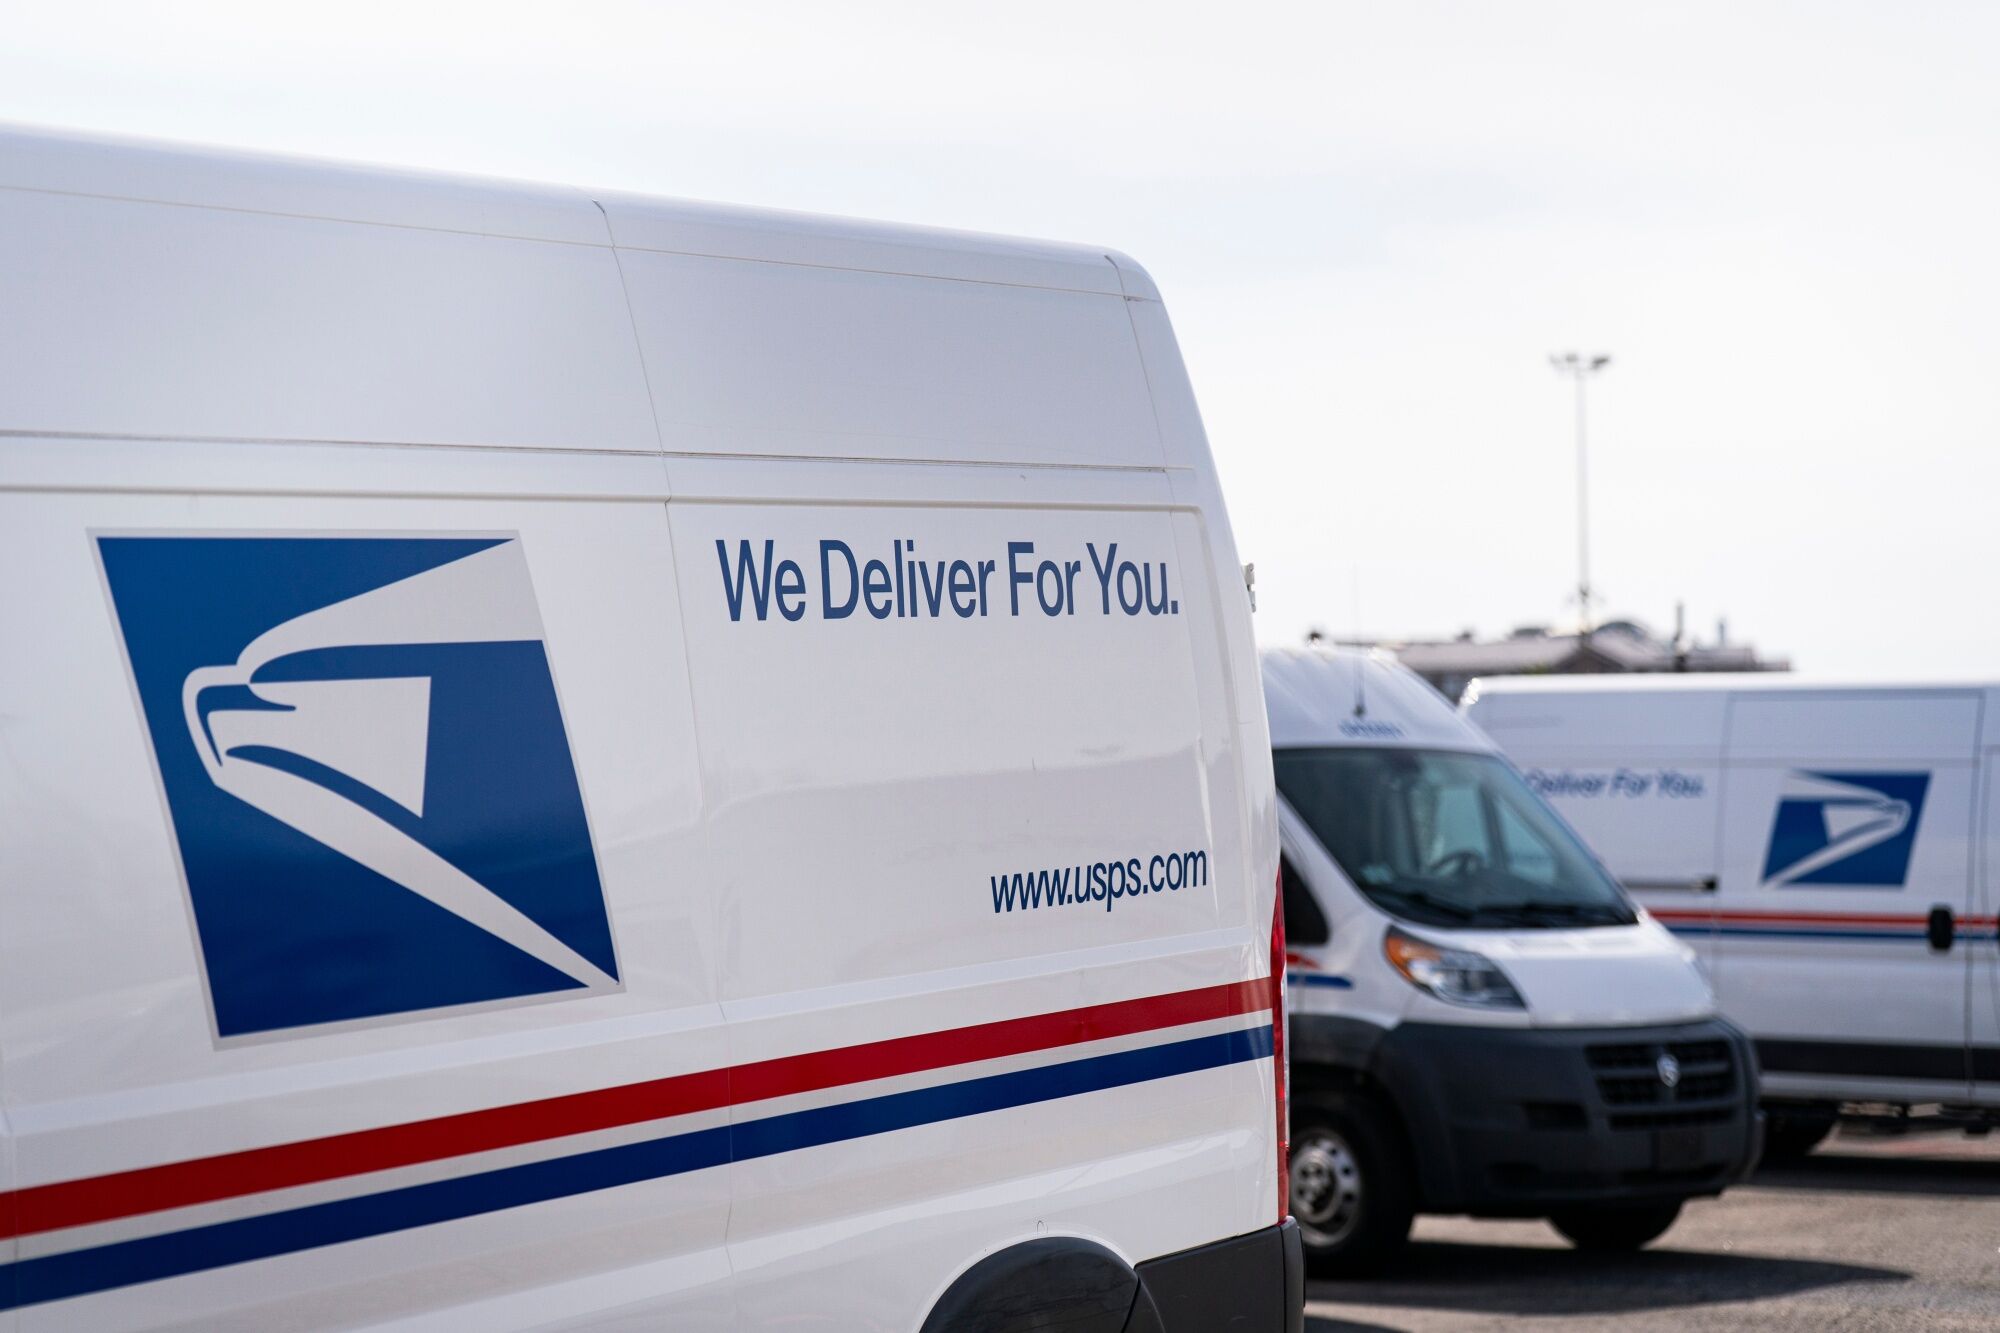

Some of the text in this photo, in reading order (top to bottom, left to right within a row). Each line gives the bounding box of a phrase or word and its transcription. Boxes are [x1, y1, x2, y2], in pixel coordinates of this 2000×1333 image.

[715, 539, 1179, 622] We Deliver For You.
[1608, 768, 1653, 798] For
[990, 849, 1207, 914] www.usps.com
